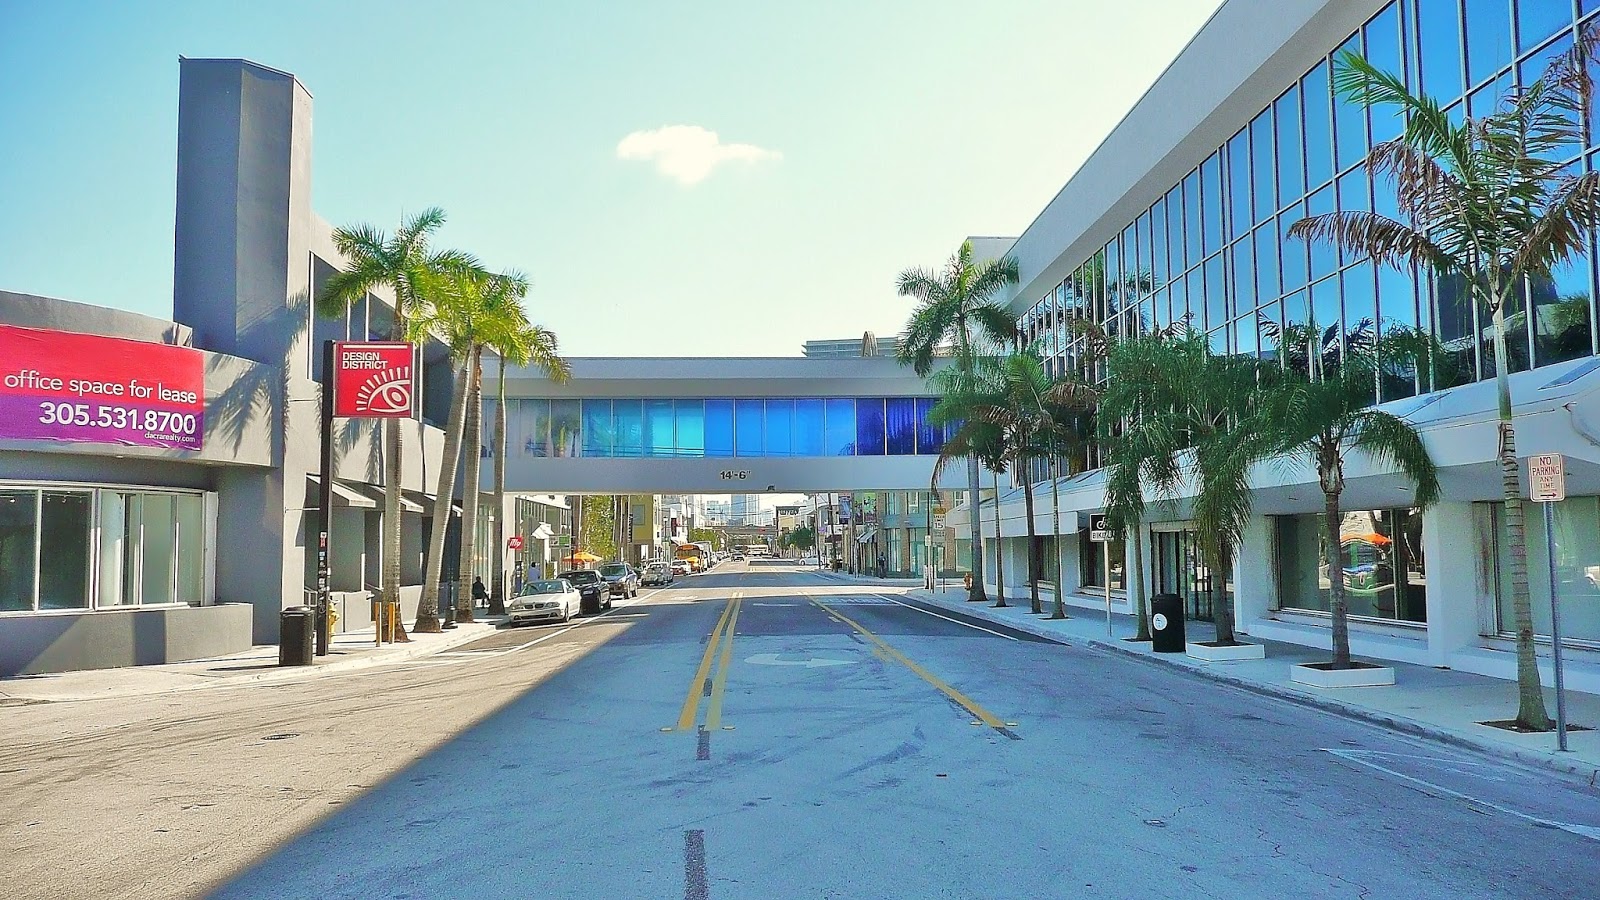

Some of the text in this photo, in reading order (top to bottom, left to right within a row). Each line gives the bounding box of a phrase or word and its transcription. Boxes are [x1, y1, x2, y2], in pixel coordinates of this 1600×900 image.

[342, 352, 380, 361] DESIGN
[342, 361, 388, 369] DISTRICT
[4, 370, 197, 404] office space for lease
[39, 402, 196, 434] 305.531.8700
[144, 431, 196, 443] dacrarealty.com
[1540, 457, 1551, 465] NO
[1532, 466, 1559, 475] PARKING
